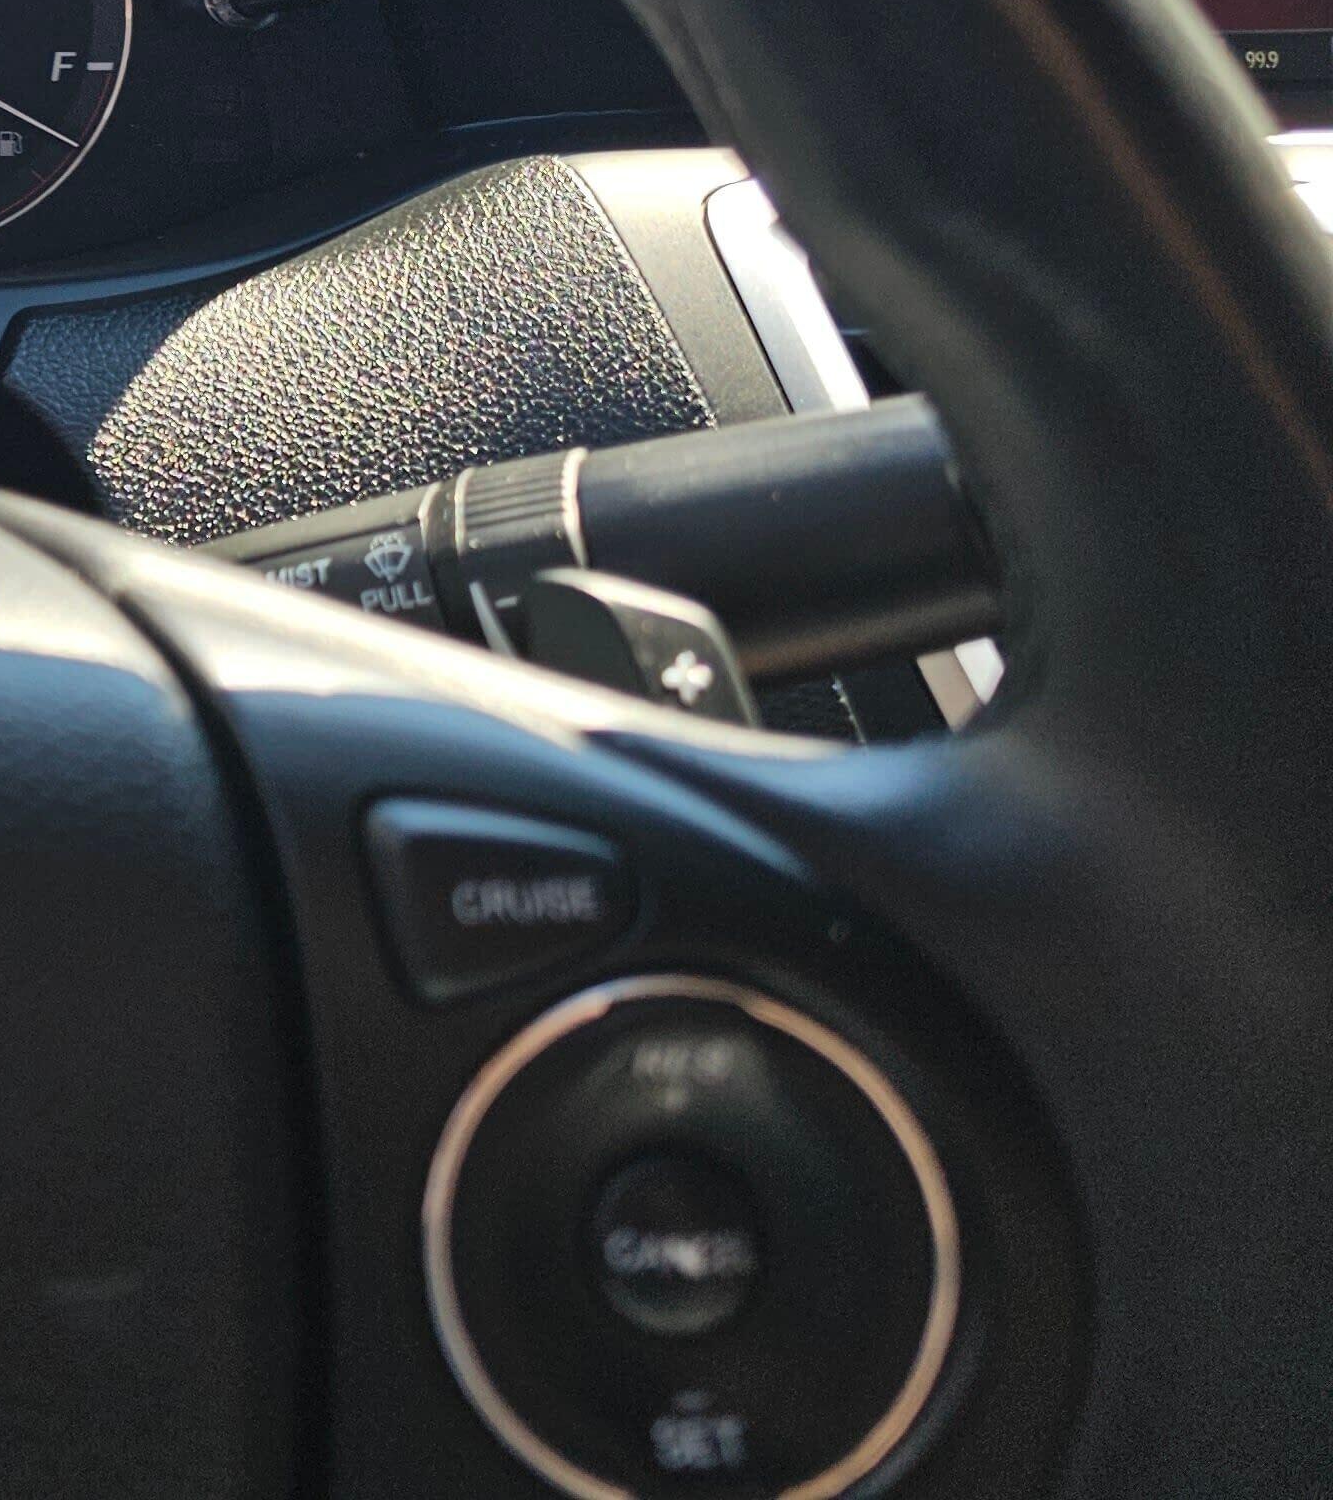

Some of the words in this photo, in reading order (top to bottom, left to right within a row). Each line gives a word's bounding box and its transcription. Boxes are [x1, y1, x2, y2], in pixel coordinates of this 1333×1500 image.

[52, 52, 76, 81] F
[1245, 50, 1279, 68] 99.9
[360, 581, 433, 612] PULL
